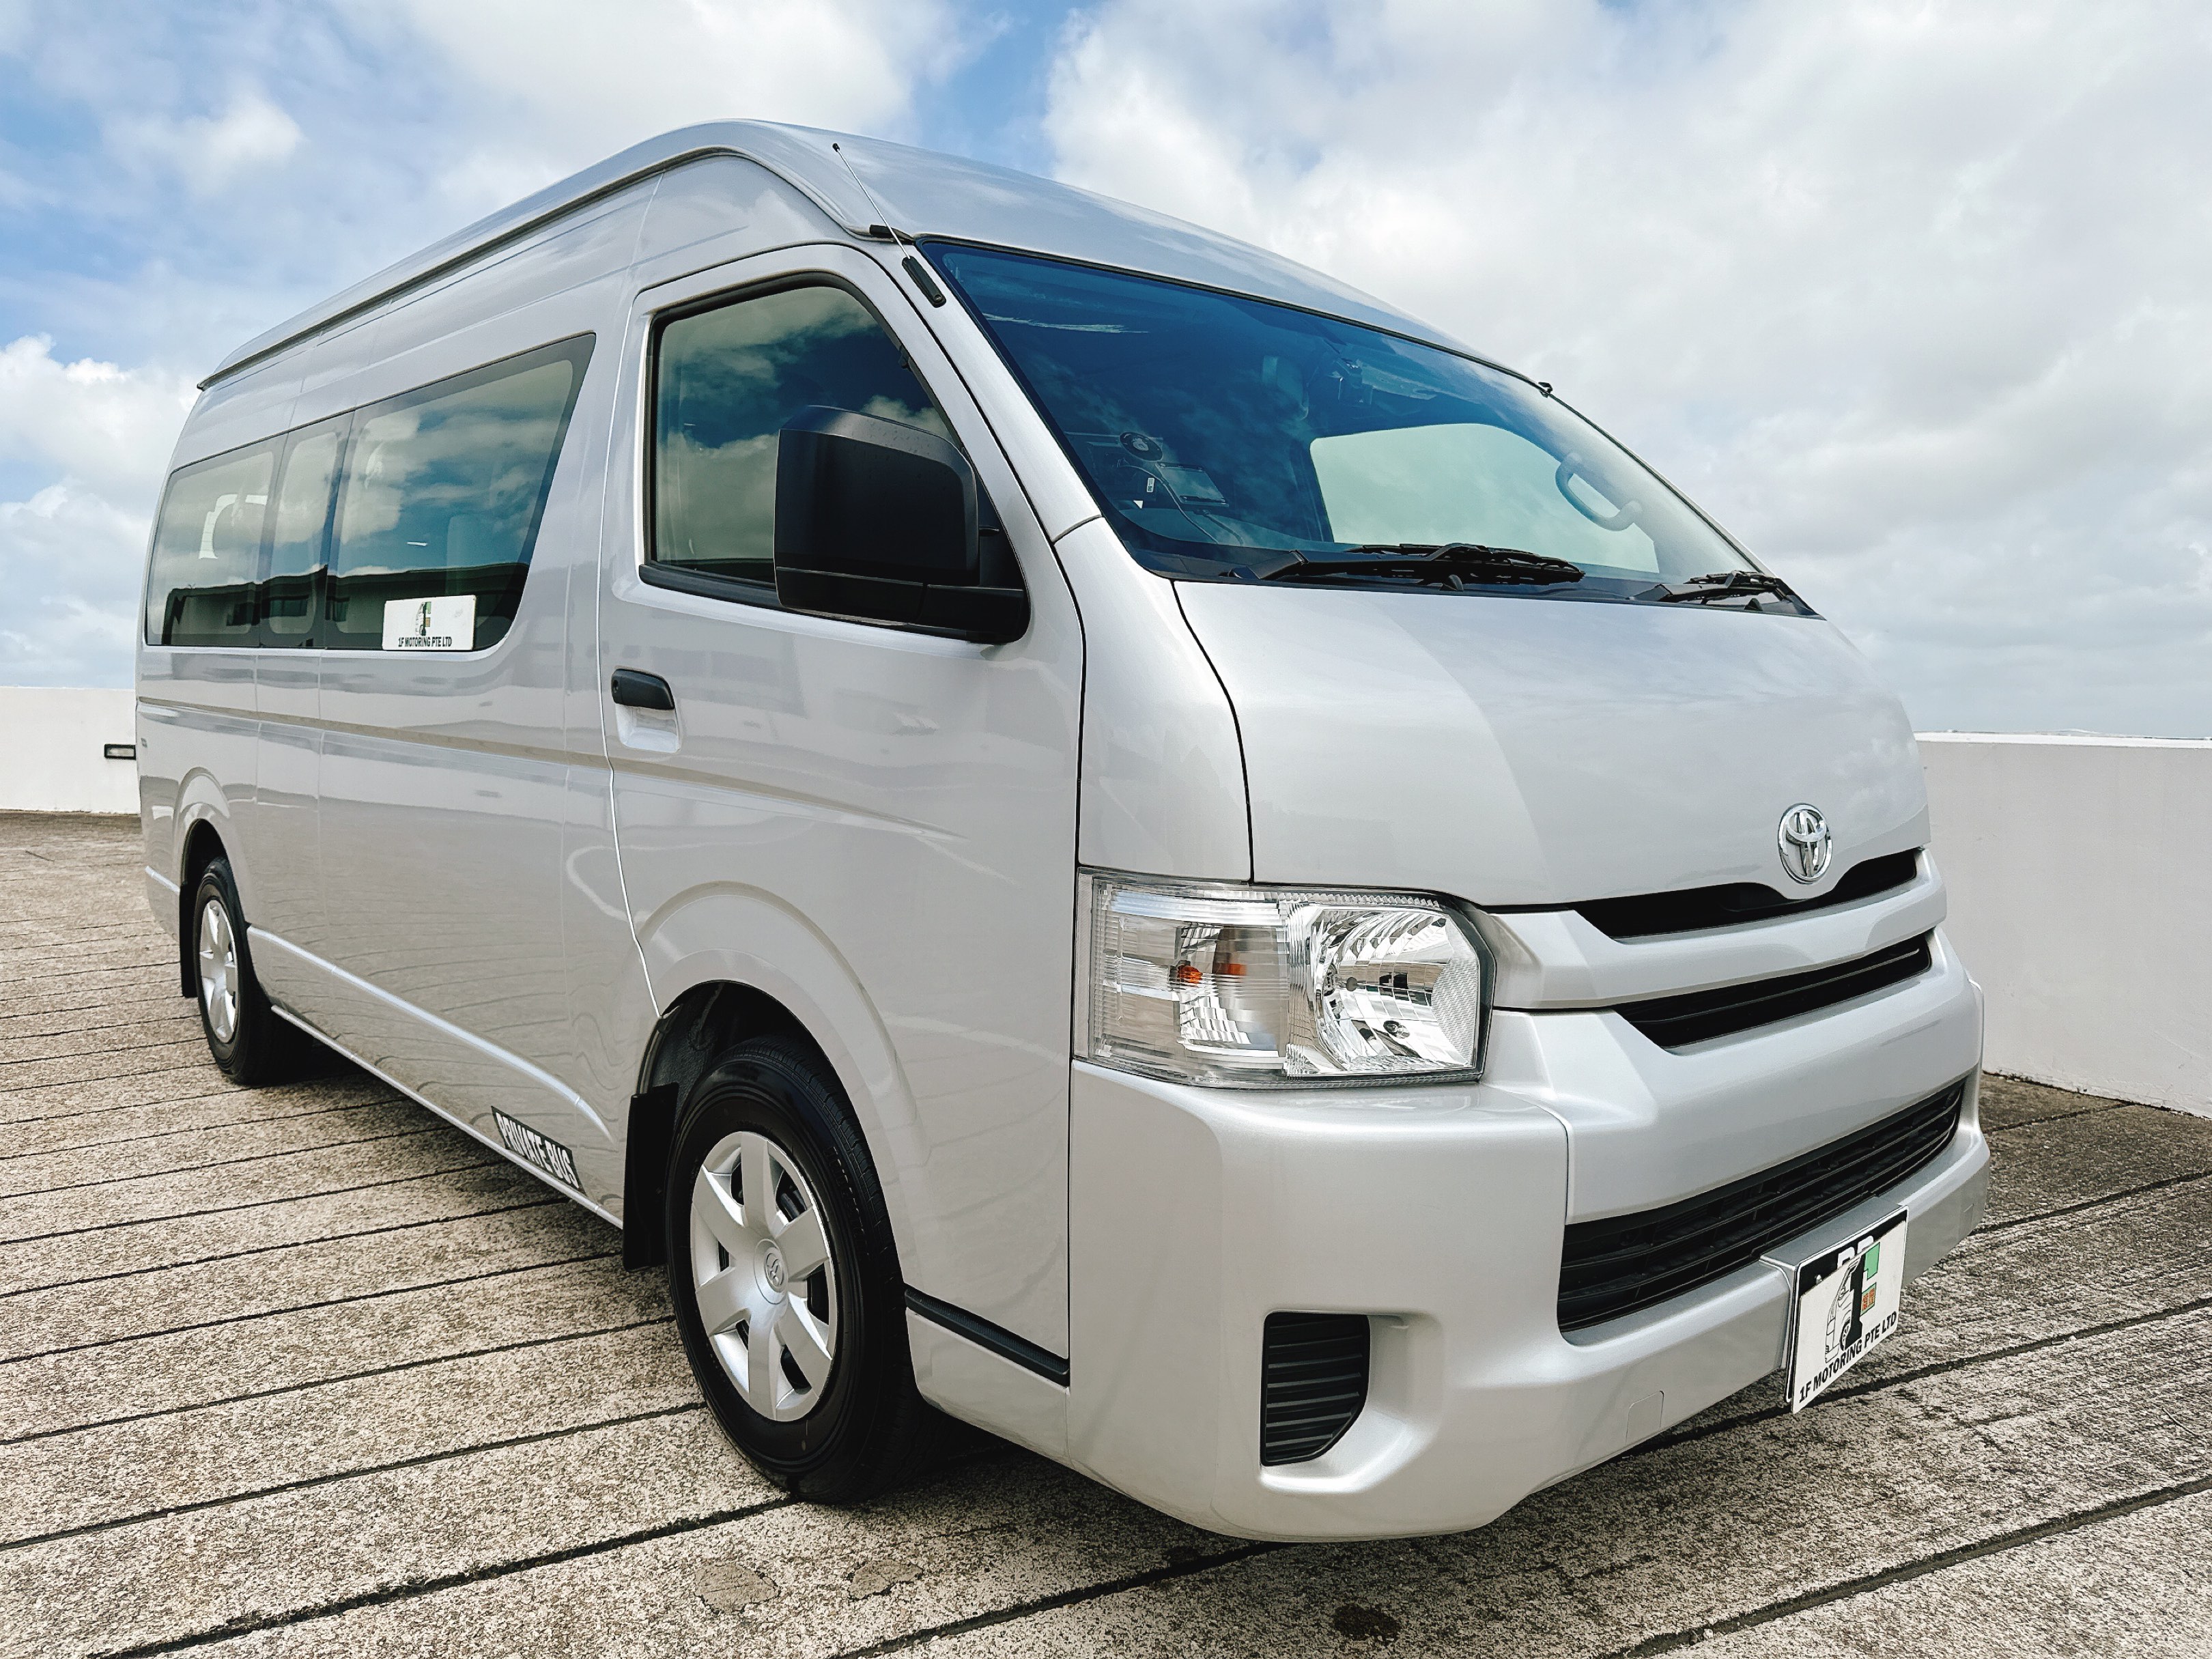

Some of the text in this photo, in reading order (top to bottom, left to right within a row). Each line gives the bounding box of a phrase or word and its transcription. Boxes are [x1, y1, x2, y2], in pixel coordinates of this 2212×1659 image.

[398, 636, 452, 647] 1F MOTORING PTE LTD
[496, 1112, 580, 1189] PRIVATE BUS
[1799, 1311, 1897, 1403] 1F MOTORING PTE LTD
